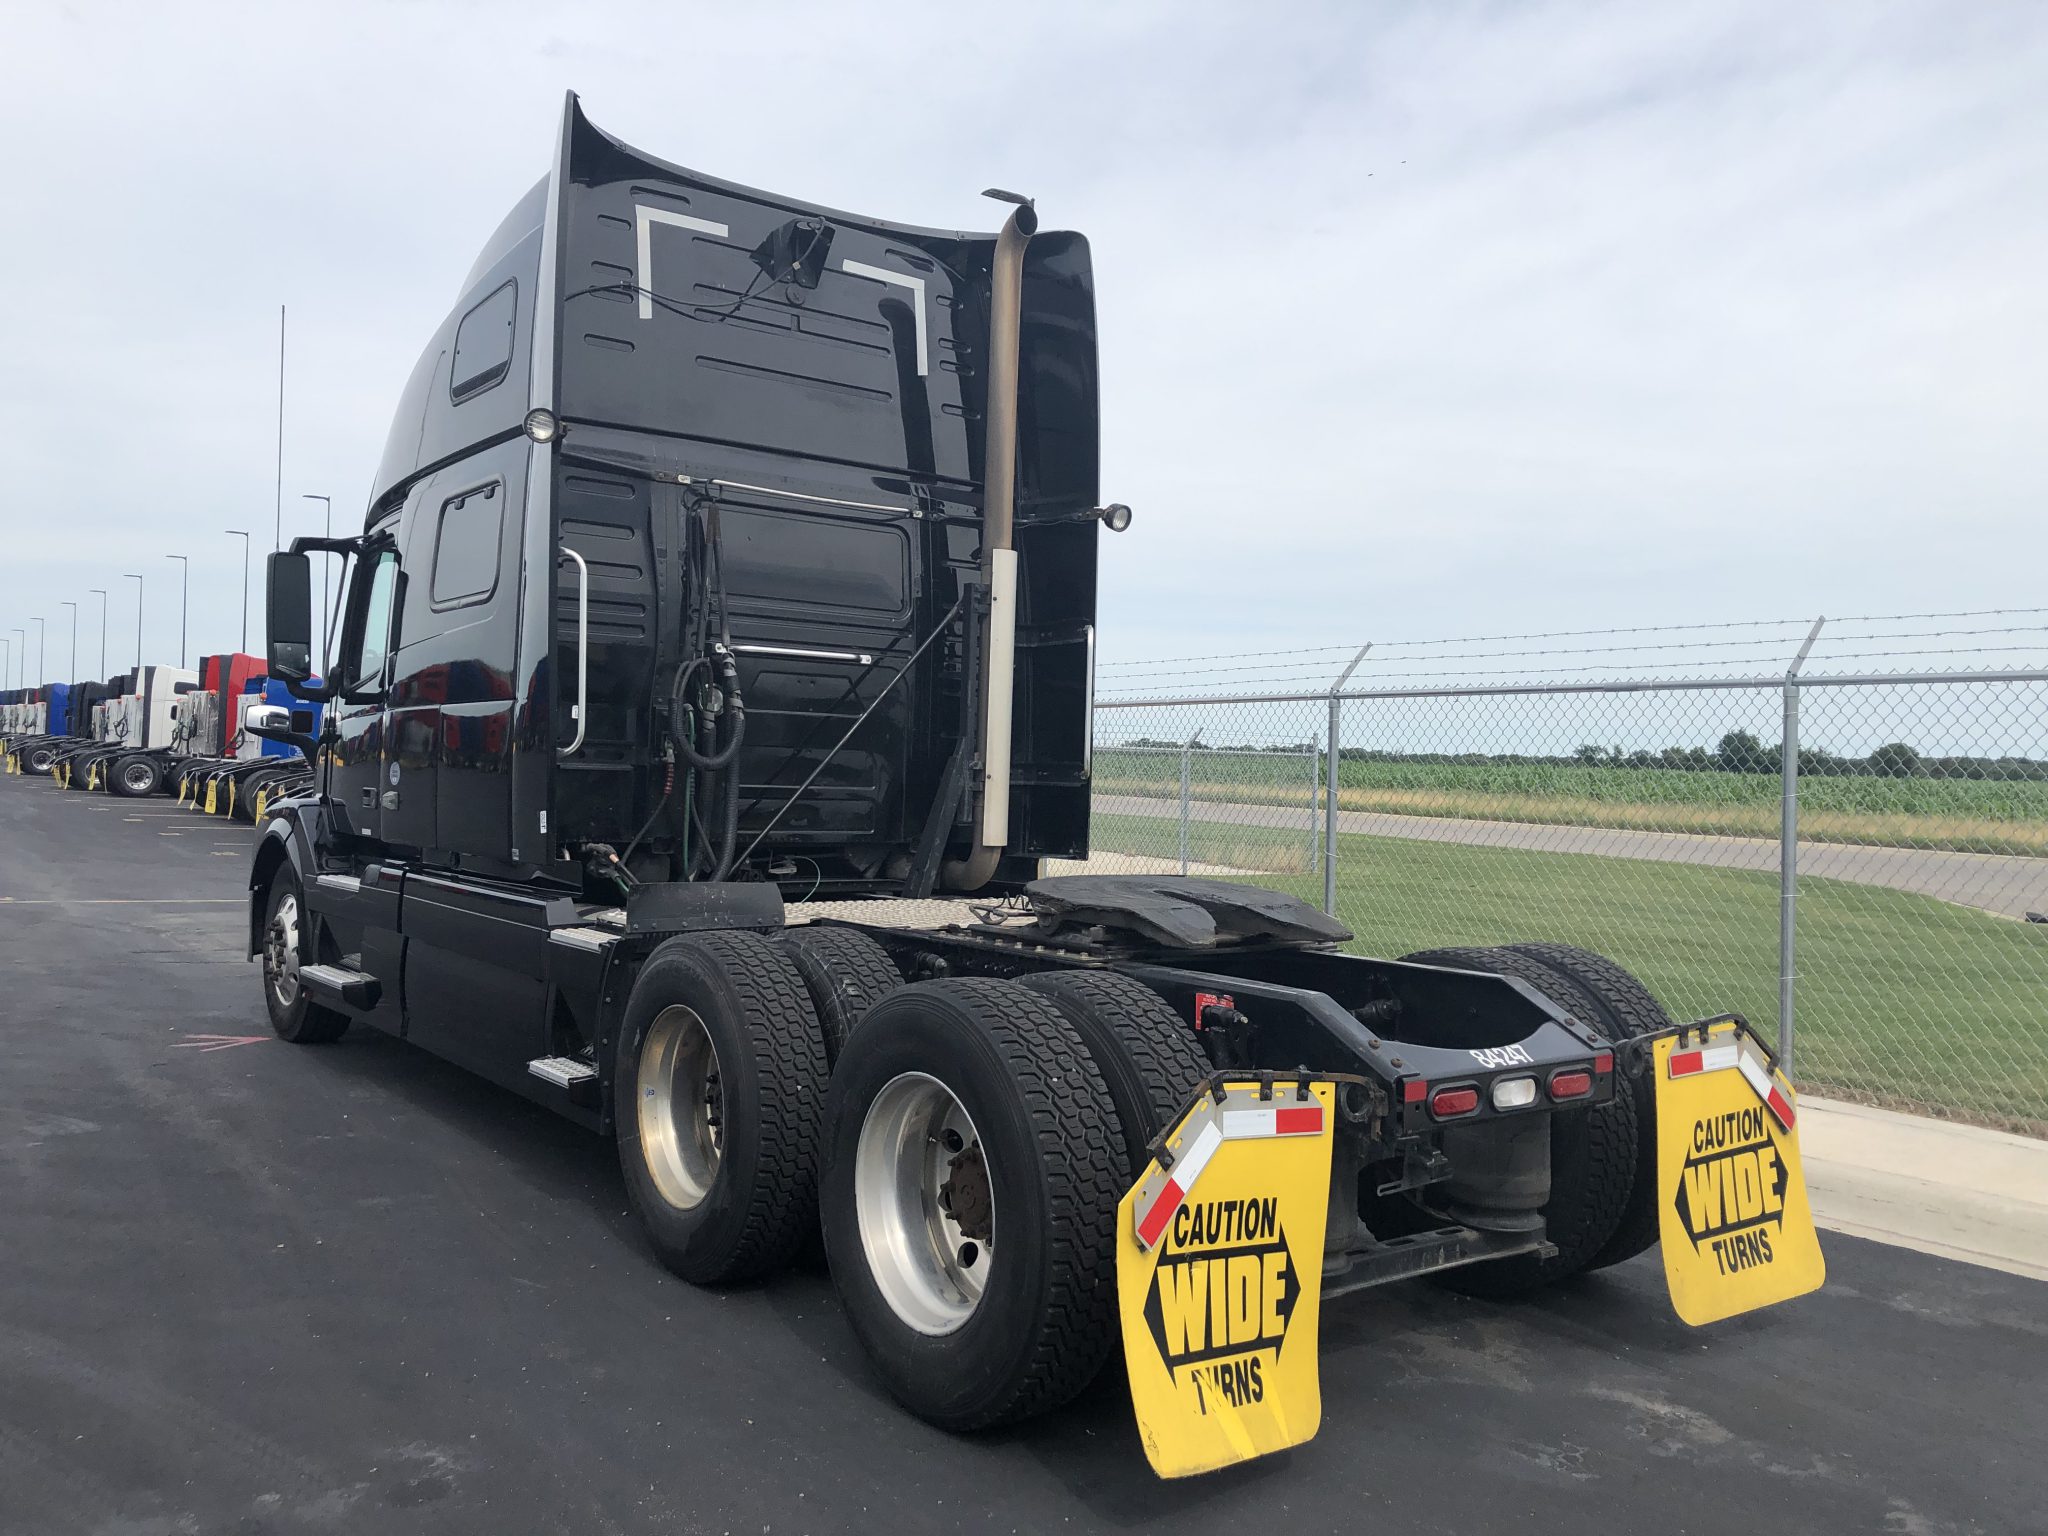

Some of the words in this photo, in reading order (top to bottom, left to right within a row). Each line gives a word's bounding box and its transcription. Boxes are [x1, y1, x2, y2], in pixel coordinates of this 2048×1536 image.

[1469, 1044, 1534, 1068] 84247
[1694, 1106, 1764, 1153] CAUTION
[1684, 1146, 1782, 1234] WIDE
[1174, 1197, 1278, 1248] CAUTION
[1712, 1227, 1773, 1275] TURNS
[1157, 1252, 1288, 1356] WIDE
